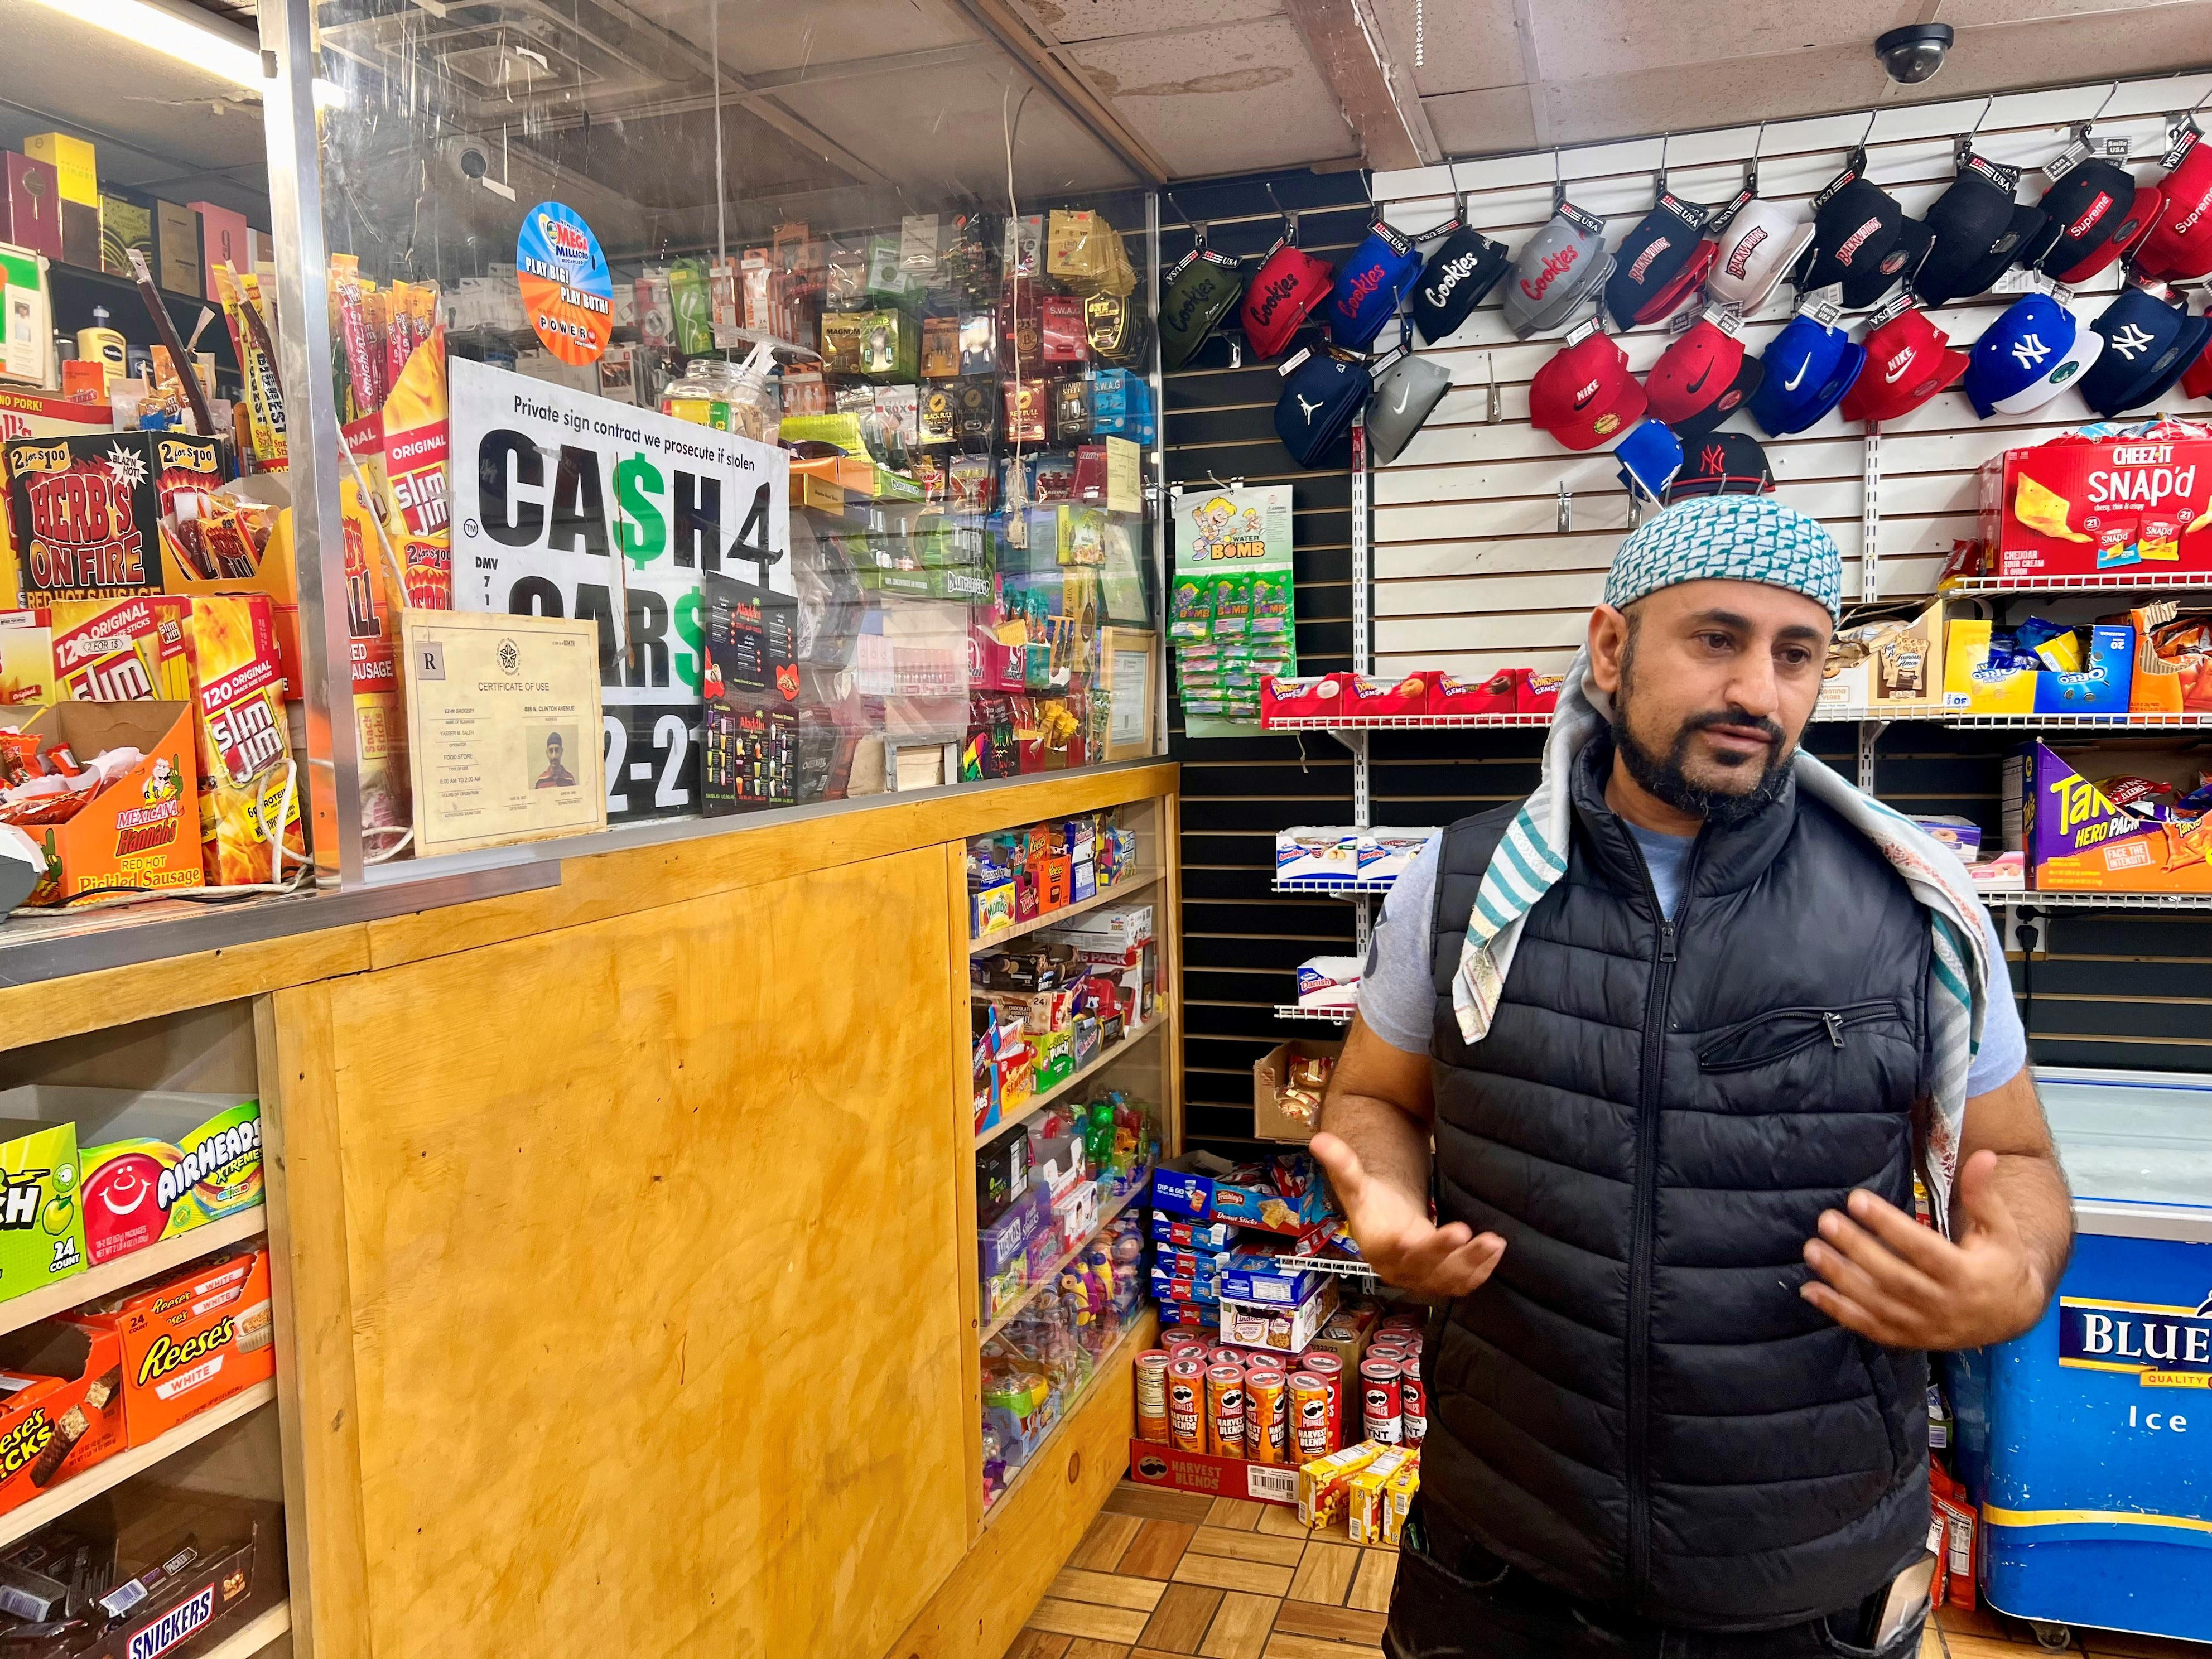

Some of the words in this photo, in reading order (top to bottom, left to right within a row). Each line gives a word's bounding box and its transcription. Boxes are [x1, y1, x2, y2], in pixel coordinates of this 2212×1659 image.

[2162, 152, 2181, 168] USA
[1992, 173, 2009, 191] USA
[1579, 216, 1598, 232] USA
[1681, 210, 1699, 228] USA
[2071, 196, 2109, 237] Supreme
[556, 223, 589, 251] MEGA
[1419, 230, 1438, 242] USA
[1835, 216, 1882, 267] BACKWOODS
[556, 245, 589, 259] MILLIONS
[1391, 238, 1408, 254] USA
[1726, 226, 1767, 280] BACKWOODS
[1222, 257, 1238, 267] USA
[1628, 237, 1671, 284] BACKWOODS
[525, 256, 548, 277] PLAY
[550, 266, 569, 284] BIG!
[1520, 244, 1578, 301] Cookies
[1425, 251, 1478, 308] Cookies
[1250, 273, 1299, 326] Cookies
[1337, 263, 1385, 319] Cookies
[560, 286, 581, 305] PLAY
[583, 296, 609, 315] BOTH!
[1168, 279, 1215, 332] Cookies
[1818, 311, 1830, 322] USA
[1720, 321, 1733, 332] USA
[1887, 346, 1913, 371] NIKE
[1575, 378, 1601, 402] NIKE
[0, 393, 13, 406] NO
[14, 396, 43, 412] PORK!
[514, 394, 560, 422] Private
[564, 410, 590, 433] sign
[594, 421, 641, 443] contract
[644, 433, 662, 447] we
[664, 437, 714, 463] prosecute
[717, 447, 726, 464] if
[161, 443, 174, 463] 2
[174, 445, 186, 461] for
[392, 434, 447, 461] ORIGINAL
[2113, 445, 2174, 465] CHEEZ-IT
[12, 451, 25, 469] 2
[25, 449, 38, 466] for
[112, 454, 138, 467] BLAZ'N
[122, 466, 140, 478] HOT!
[394, 471, 448, 512] slim
[31, 474, 133, 546] HERB'S
[478, 428, 722, 573] CA$H
[727, 481, 784, 591] 4
[2094, 503, 2112, 512] cheesy,
[2129, 503, 2144, 512] crispy
[2180, 510, 2191, 519] 21
[2086, 519, 2098, 528] 21
[407, 545, 417, 565] 2
[418, 546, 430, 561] for
[1211, 541, 1265, 560] BOMB
[2004, 550, 2038, 560] CHEDDAR
[30, 539, 73, 589] ON
[76, 531, 146, 587] FIRE
[475, 556, 499, 571] DMV
[2022, 560, 2044, 568] CREAM
[484, 576, 491, 588] 7
[1179, 609, 1210, 619] BOMB
[1217, 605, 1249, 615] BOMB
[1254, 604, 1287, 615] BOMB
[90, 602, 150, 639] ORIGINAL
[127, 617, 151, 634] STICKS
[161, 622, 177, 634] slim
[88, 642, 93, 651] 2
[93, 640, 108, 650] FOR
[111, 639, 119, 649] 1$
[166, 629, 180, 643] jim
[423, 652, 436, 670] R
[1895, 654, 1921, 662] Famous
[351, 660, 393, 681] AUSAGE
[2059, 668, 2105, 684] OREO
[202, 681, 233, 710] 120
[232, 660, 272, 688] ORIGINAL
[478, 682, 523, 691] CERTIFICATE
[524, 683, 534, 691] OF
[536, 682, 549, 691] USE
[1360, 688, 1379, 699] GEMS
[1445, 686, 1467, 697] GEMS
[212, 700, 275, 755] slim
[364, 713, 375, 753] Snack
[236, 726, 284, 783] jim
[116, 799, 179, 830] MEXICANA
[2074, 821, 2108, 848] HERO
[2107, 847, 2127, 858] FACE
[2129, 844, 2146, 855] THE
[122, 859, 143, 871] RED
[146, 856, 166, 868] HOT
[2109, 854, 2146, 869] INTENSITY
[142, 868, 200, 887] Sausage
[1091, 953, 1126, 965] PACK
[1300, 978, 1332, 991] Danish
[1050, 1041, 1069, 1063] PUNCH
[157, 1118, 262, 1212] AIRHEADS
[215, 1147, 263, 1184] XTREMES
[1157, 1183, 1168, 1192] DIP
[1217, 1211, 1238, 1222] Donut
[1239, 1216, 1258, 1225] Sticks
[124, 1224, 147, 1239] PACKAGES
[54, 1236, 75, 1262] 24
[49, 1253, 80, 1273] COUNT
[152, 1291, 191, 1313] Reese's
[205, 1272, 234, 1291] WHITE
[203, 1291, 232, 1310] WHITE
[128, 1322, 148, 1334] COUNT
[129, 1314, 145, 1328] 24
[2082, 1313, 2210, 1364] BLUE
[139, 1315, 236, 1387] Reese's
[171, 1366, 211, 1392] WHITE
[2148, 1374, 2204, 1385] QUALITY
[1217, 1415, 1245, 1426] HARVEST
[2129, 1405, 2188, 1433] Ice
[1219, 1424, 1245, 1435] BLENDS
[1297, 1427, 1327, 1439] HARVEST
[1367, 1429, 1389, 1440] TNT
[1299, 1437, 1327, 1447] BLENDS
[1172, 1460, 1222, 1478] HARVEST
[1175, 1472, 1220, 1491] BLENDS
[131, 1592, 211, 1659] SNICKERS
